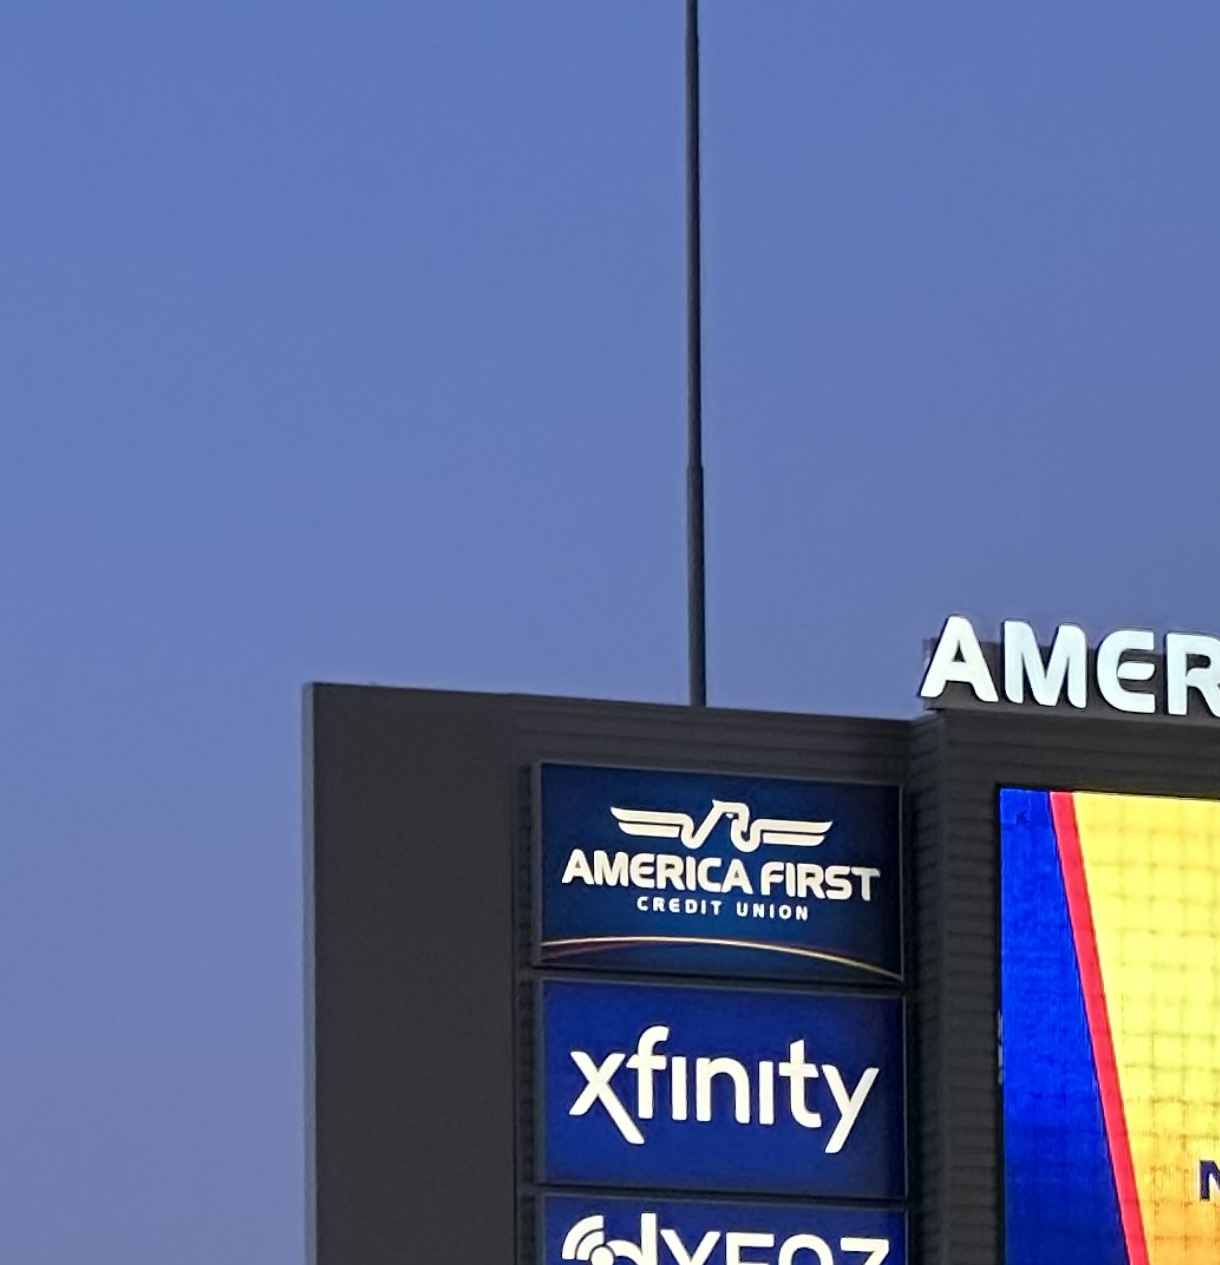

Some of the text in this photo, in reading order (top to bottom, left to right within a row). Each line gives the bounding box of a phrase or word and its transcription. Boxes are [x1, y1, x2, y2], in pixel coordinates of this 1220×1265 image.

[562, 849, 880, 901] AMERICA FIRST
[637, 896, 809, 920] CREDIT UNION
[568, 1024, 879, 1154] xfinity
